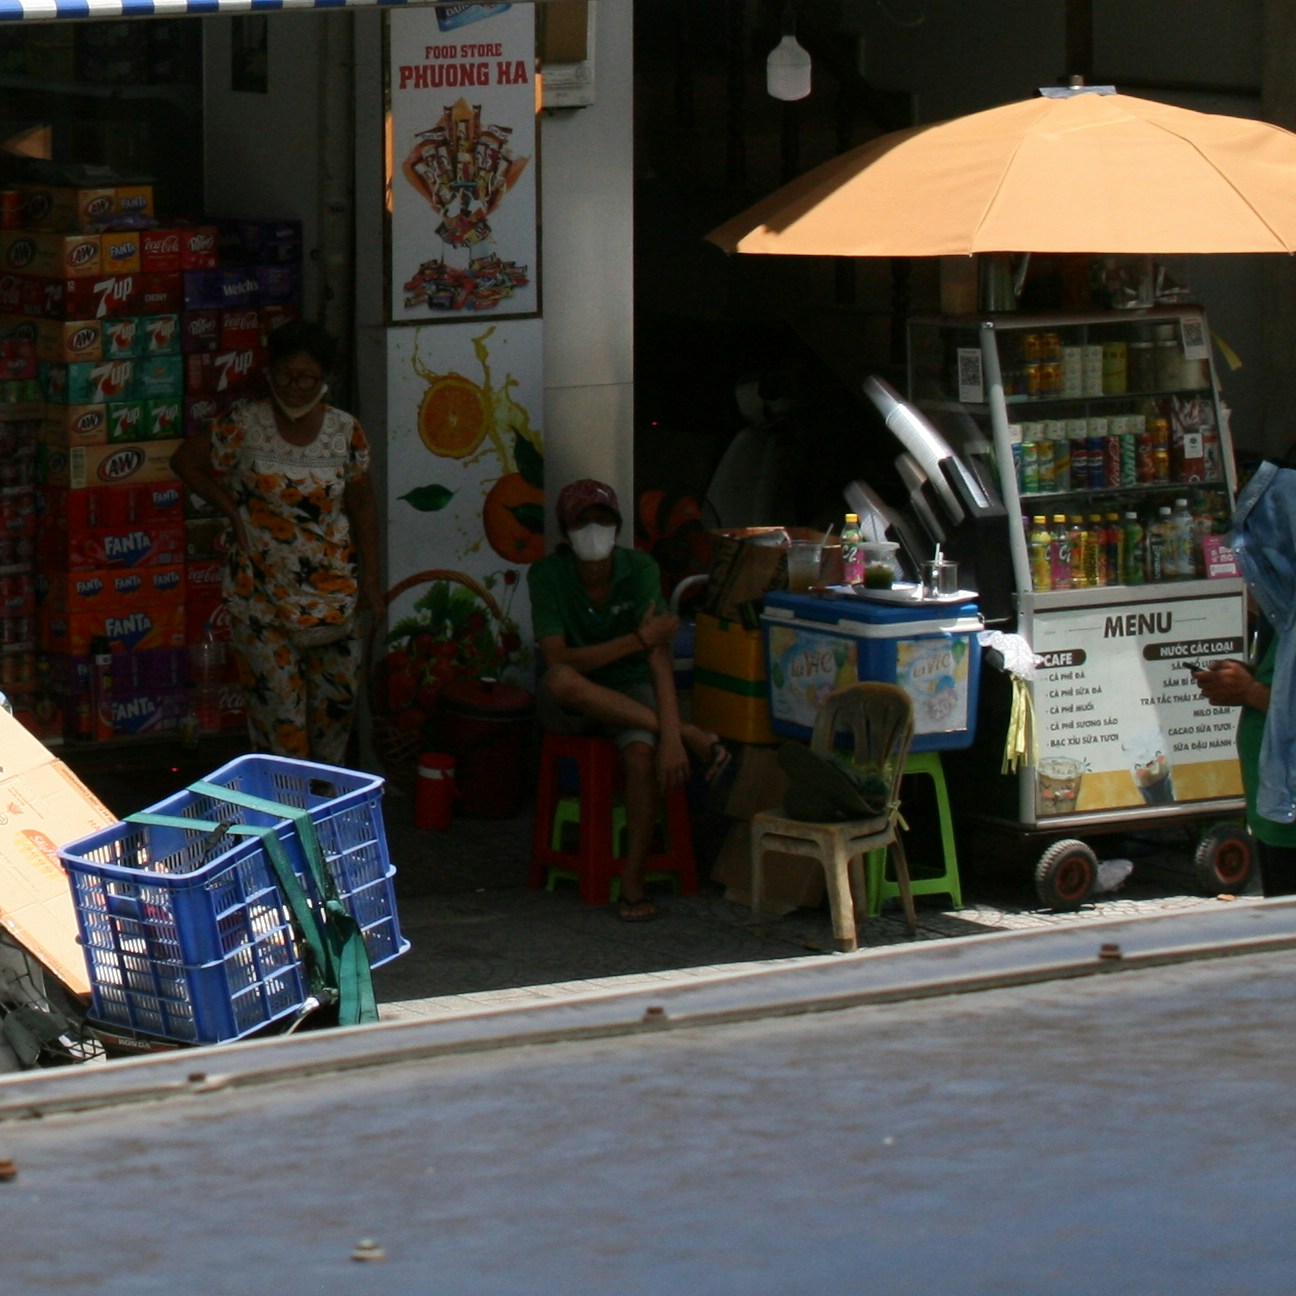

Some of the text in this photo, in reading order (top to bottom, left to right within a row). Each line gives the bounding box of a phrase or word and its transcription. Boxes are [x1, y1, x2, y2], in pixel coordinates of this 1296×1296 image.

[425, 43, 502, 59] FOOD STORE
[399, 60, 528, 89] PHUONG HA
[104, 531, 152, 555] FANTA
[105, 613, 152, 640] FANTA
[1103, 611, 1173, 638] MENU
[1044, 653, 1073, 666] CAFE
[1160, 641, 1233, 656] NƯỚC CÁC LOẠI
